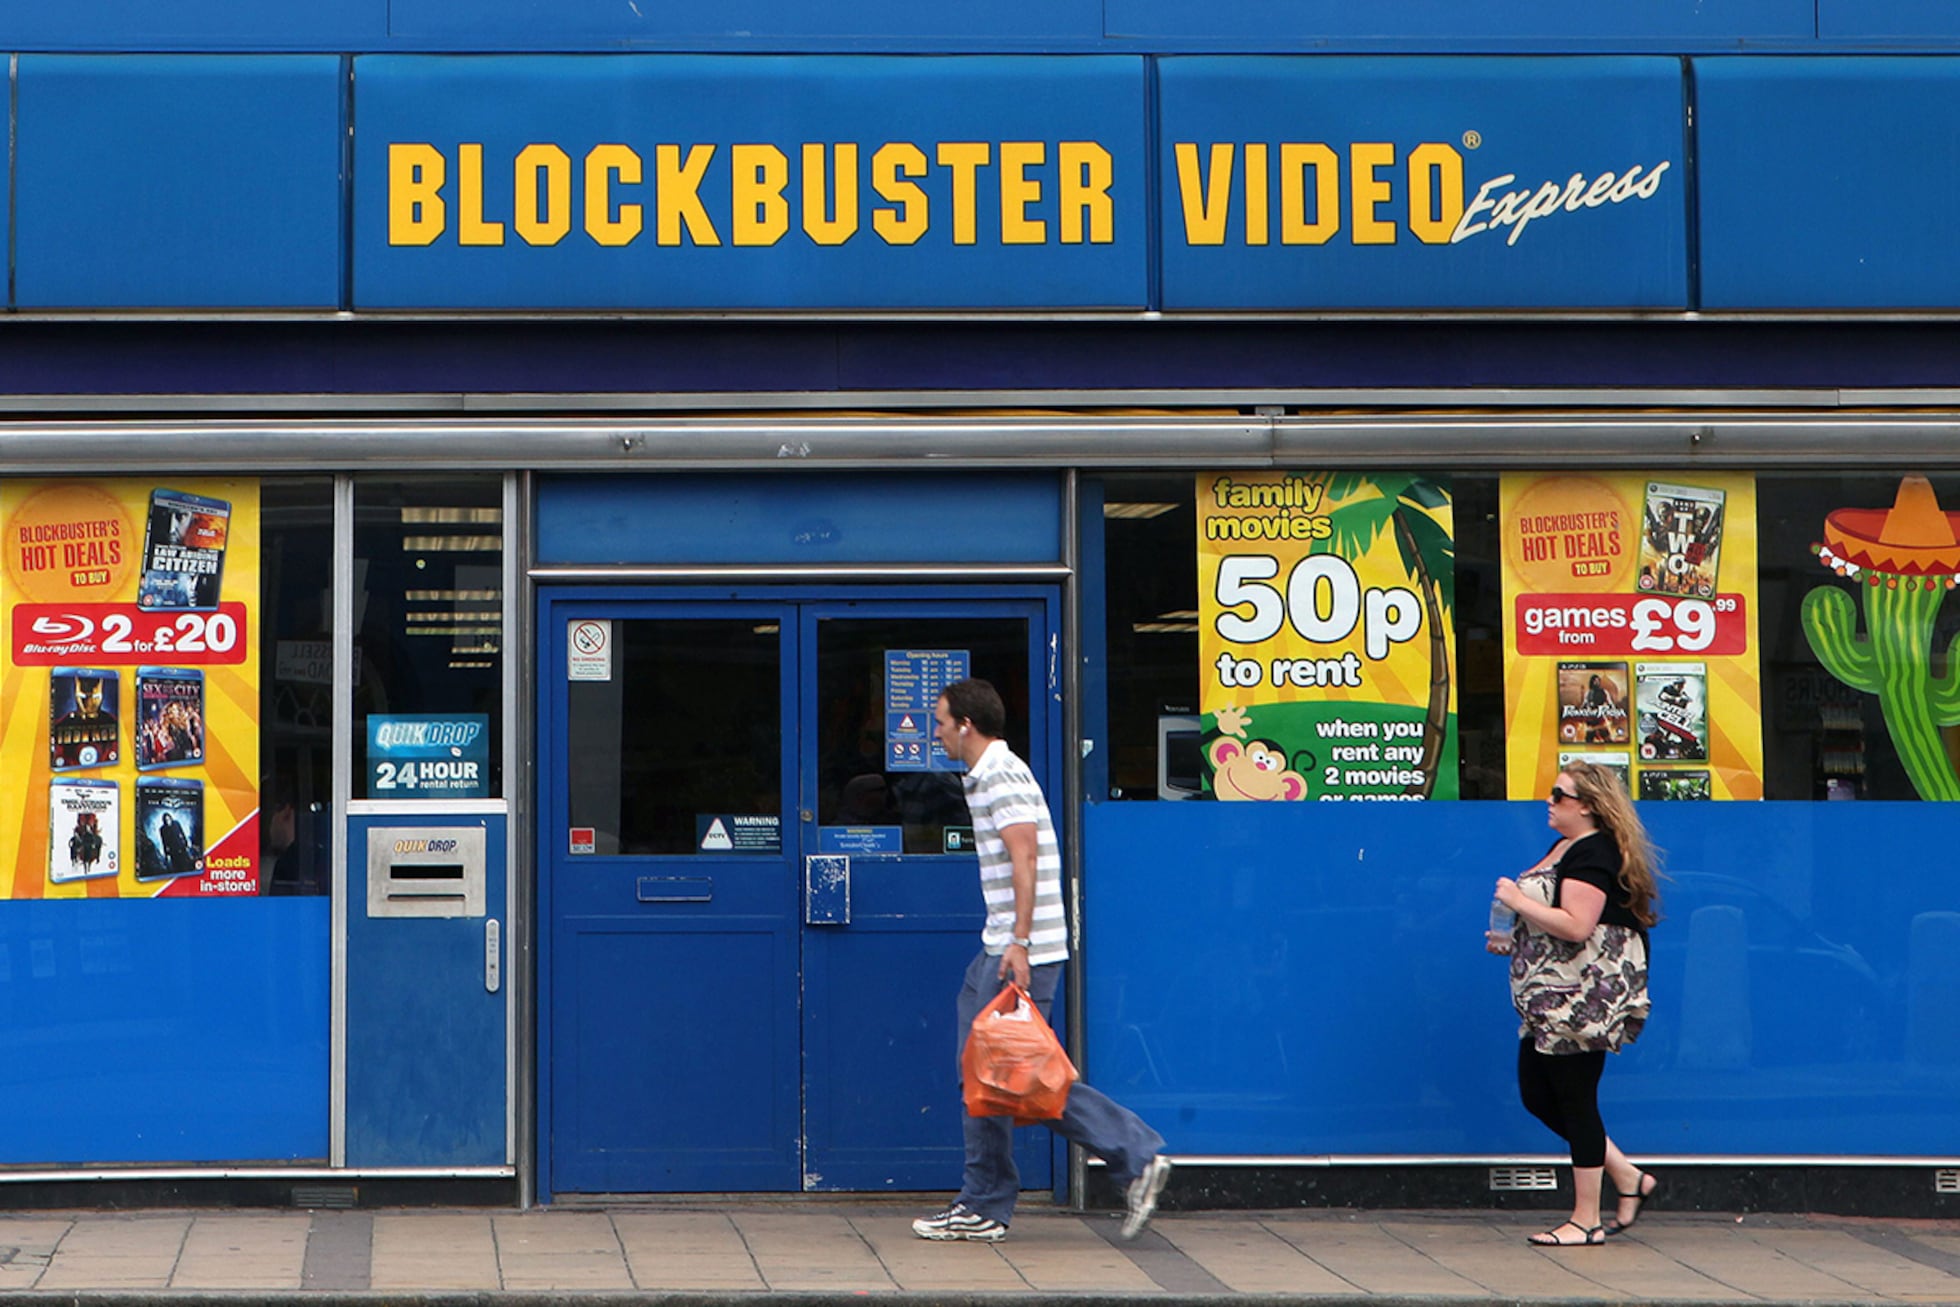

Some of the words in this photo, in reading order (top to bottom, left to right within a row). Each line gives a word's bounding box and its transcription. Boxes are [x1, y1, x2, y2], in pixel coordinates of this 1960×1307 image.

[388, 141, 1115, 246] BLOCKBUSTER
[1451, 160, 1671, 246] Express
[1213, 476, 1323, 513] family
[19, 519, 120, 544] BLOCKBUSTER'S
[1206, 509, 1333, 540] movies
[1519, 511, 1618, 535] BLOCKBUSTER'S
[21, 545, 58, 572] HOT
[64, 540, 121, 570] DEALS
[1521, 535, 1558, 562] HOT
[1564, 530, 1622, 559] DEALS
[152, 556, 218, 574] CITIZEN
[1575, 563, 1588, 575] TO
[1589, 562, 1608, 574] BUY
[73, 572, 87, 585] TO
[88, 570, 108, 584] BUY
[1215, 553, 1423, 661] 50p
[101, 613, 133, 652] 2
[134, 638, 153, 652] for
[153, 613, 237, 652] £20
[1524, 606, 1626, 635] games
[1558, 630, 1595, 644] from
[1216, 652, 1262, 688] to
[1271, 652, 1362, 688] rent
[1315, 718, 1378, 738] when
[1382, 722, 1424, 742] you
[1331, 744, 1379, 761] rent
[1383, 747, 1424, 764] any
[376, 761, 418, 789] 24
[420, 762, 478, 779] HOUR
[419, 780, 448, 789] rental
[449, 780, 479, 789] return
[1324, 766, 1339, 786] 2
[1344, 765, 1426, 786] movies
[733, 816, 779, 826] WARNING
[205, 856, 251, 868] Loads
[210, 868, 246, 880] more
[200, 879, 256, 892] in-store!
